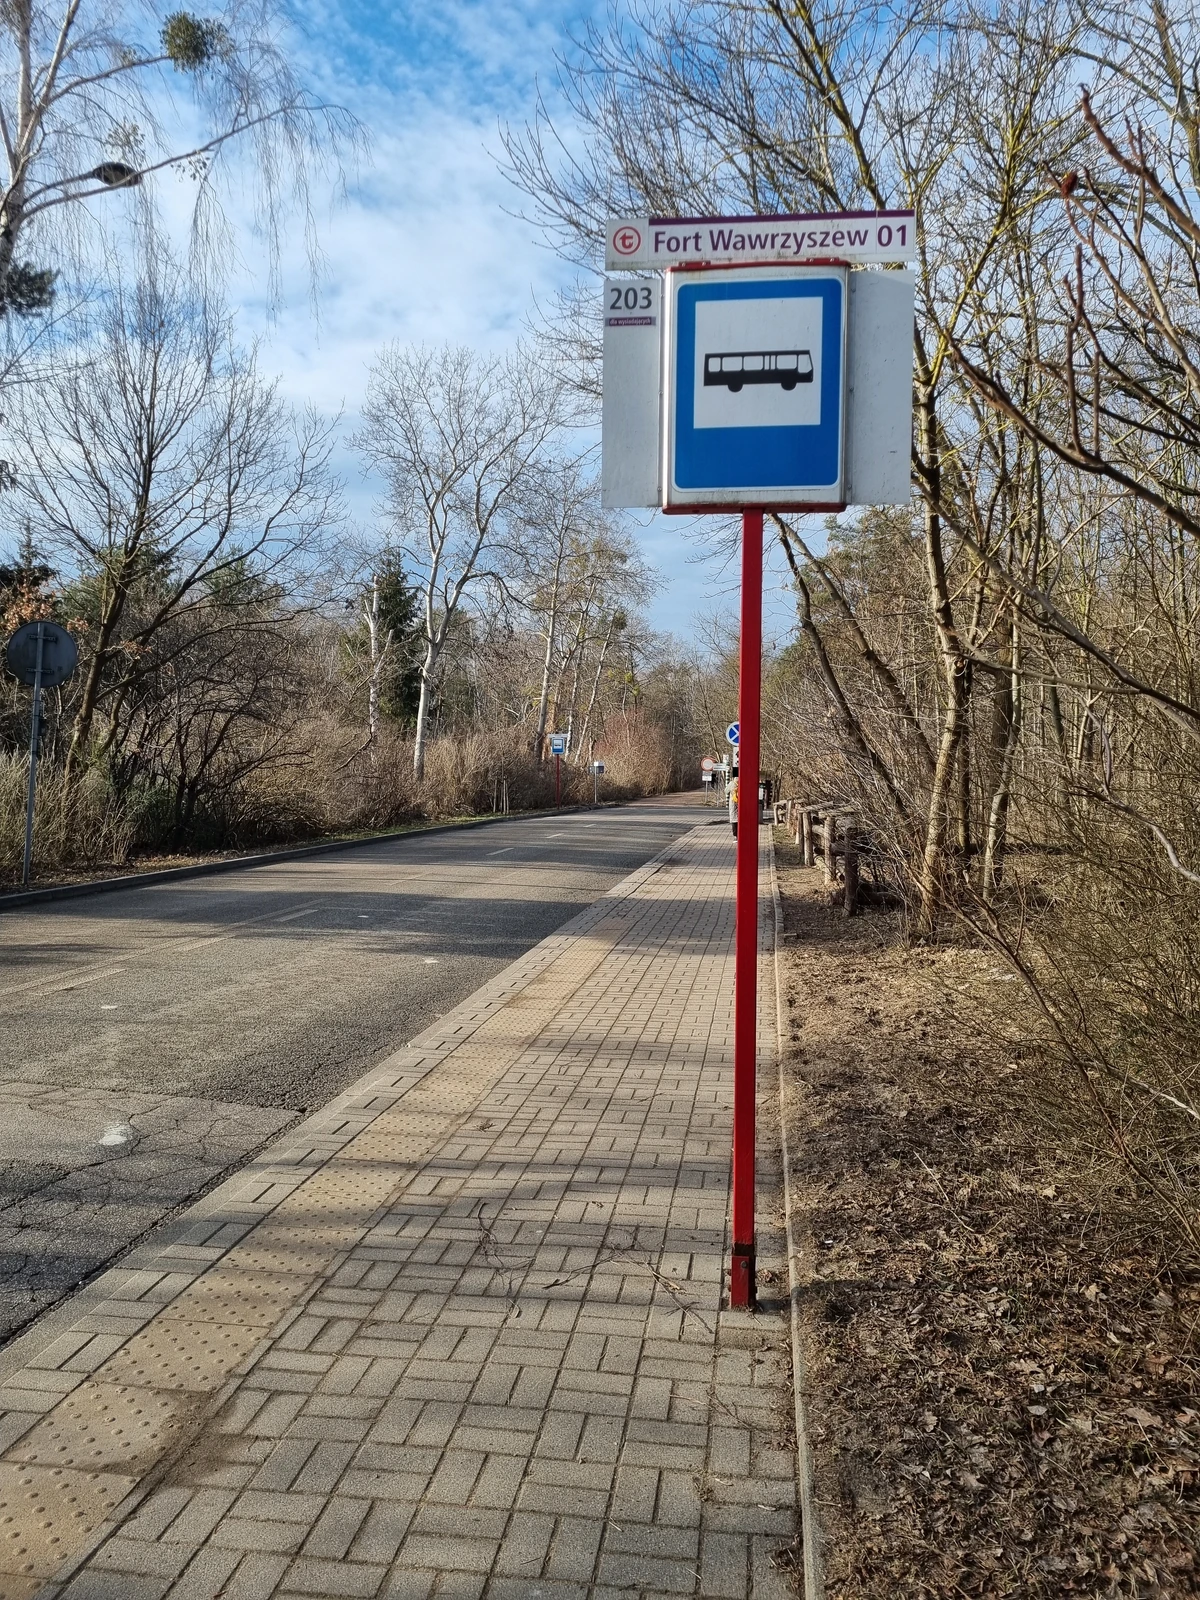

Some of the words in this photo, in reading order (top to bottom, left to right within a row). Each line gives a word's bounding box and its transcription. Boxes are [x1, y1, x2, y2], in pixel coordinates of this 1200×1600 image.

[654, 230, 702, 253] Fort
[709, 228, 869, 255] Wawrzyszew
[877, 224, 907, 247] 01
[610, 287, 652, 310] 203
